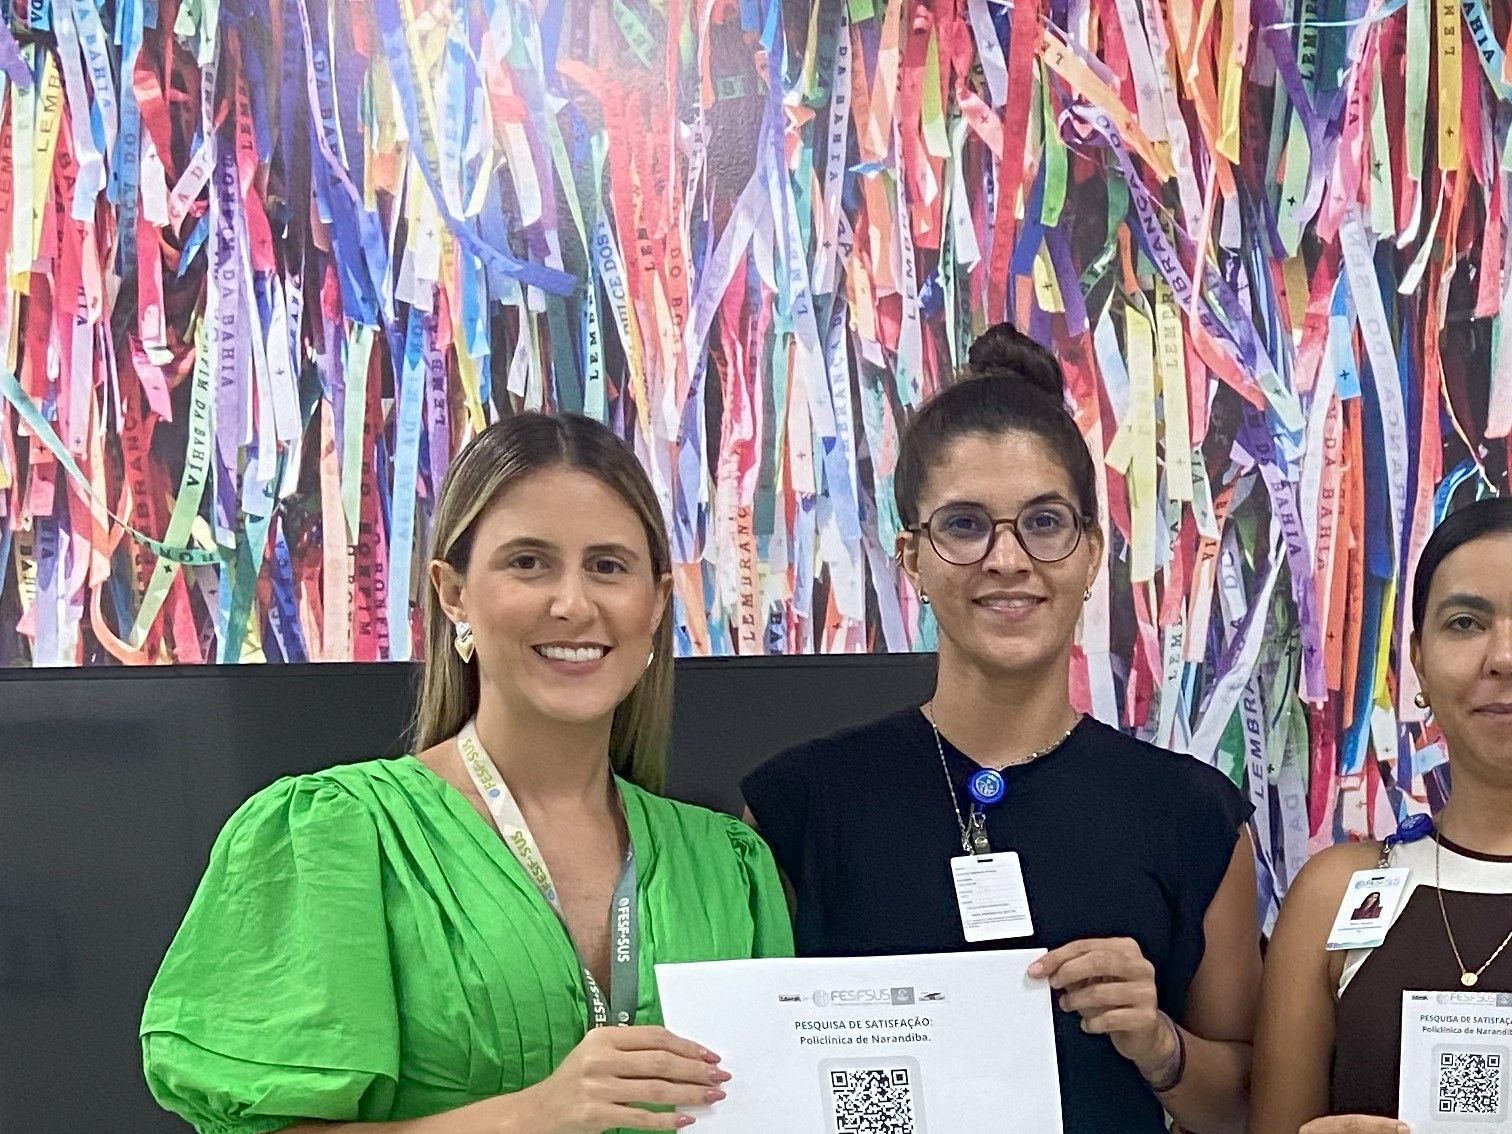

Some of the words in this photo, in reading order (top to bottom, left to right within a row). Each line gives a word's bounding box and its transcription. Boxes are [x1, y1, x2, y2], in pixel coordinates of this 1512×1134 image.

[185, 427, 208, 489] BAHIA
[1324, 438, 1338, 468] DA
[1270, 480, 1303, 558] BAHIA
[795, 1019, 847, 1032] PESQUISA
[849, 1019, 862, 1030] DE
[1419, 1014, 1459, 1024] PESQUISA
[1460, 1015, 1472, 1023] DE
[1463, 1027, 1475, 1035] de
[800, 1033, 853, 1046] Policlínica
[856, 1034, 869, 1045] de
